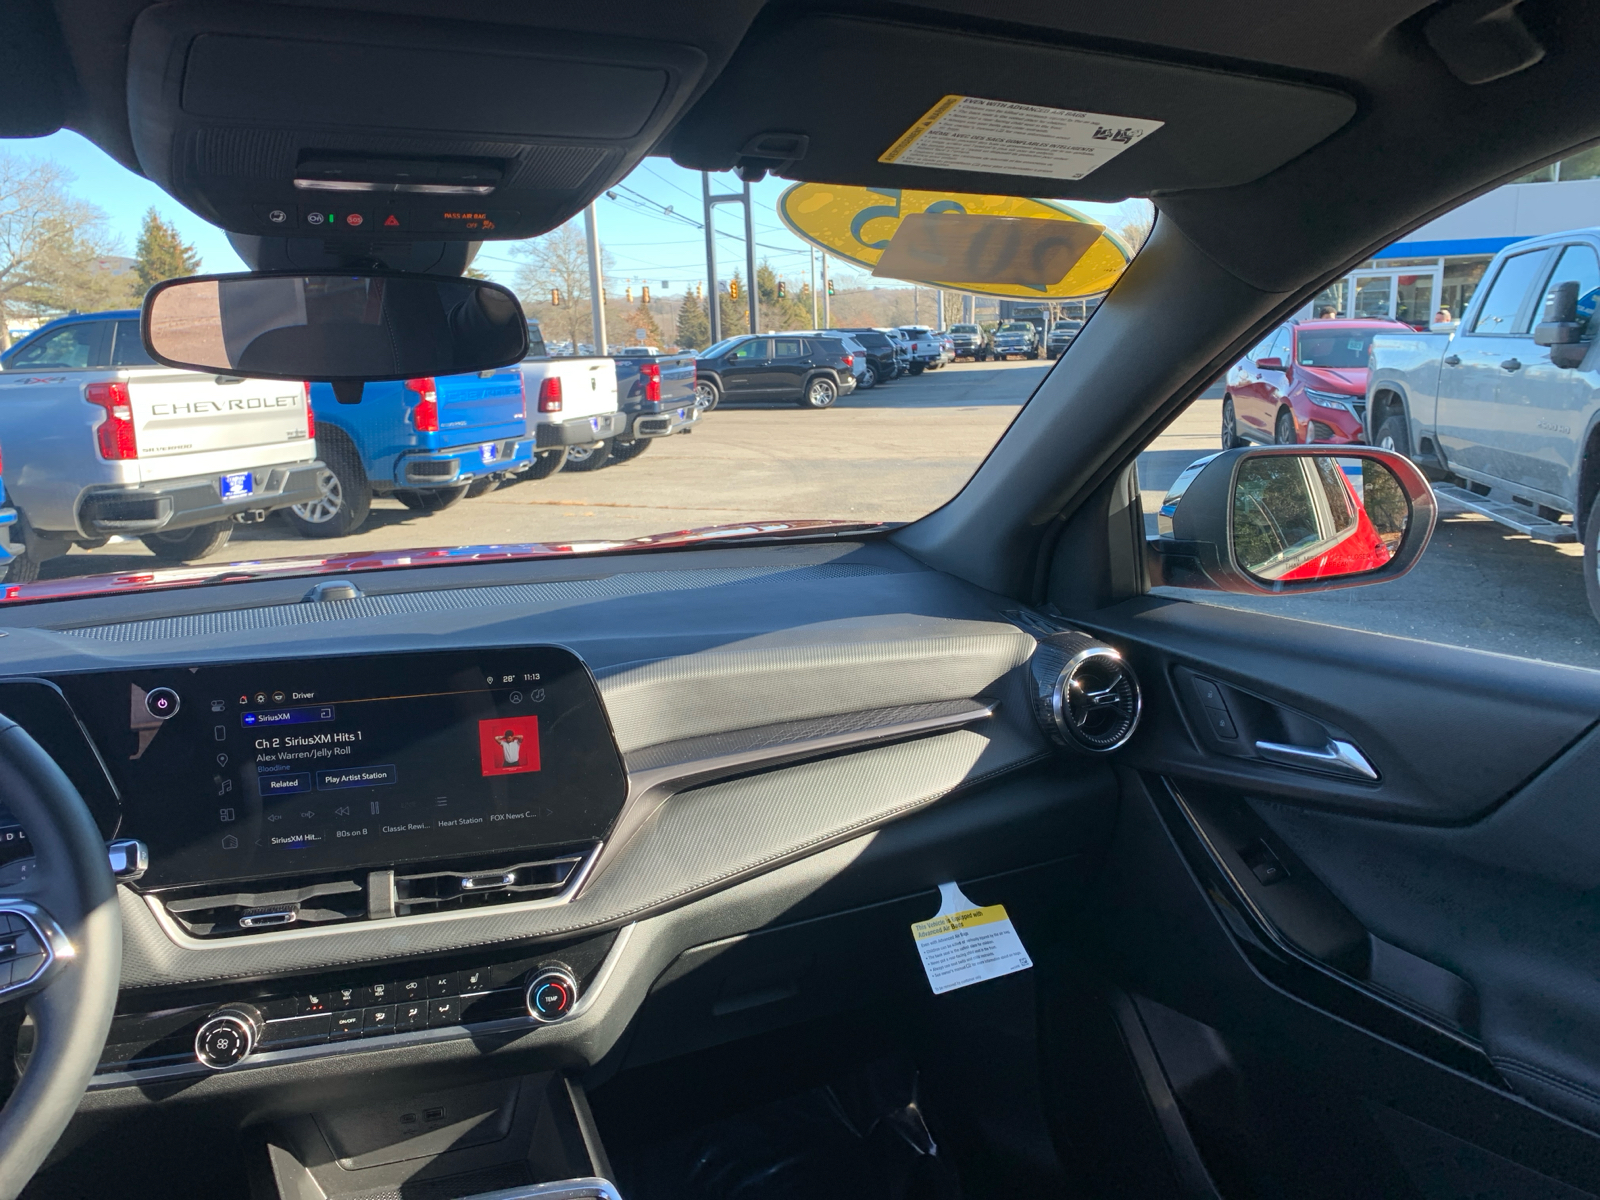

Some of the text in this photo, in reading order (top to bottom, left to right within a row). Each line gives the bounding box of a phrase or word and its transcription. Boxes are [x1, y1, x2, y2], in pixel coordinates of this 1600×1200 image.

[1007, 104, 1050, 112] ADVANCED
[151, 395, 299, 416] CHEVROLET
[258, 713, 290, 722] SiriusXM
[255, 738, 270, 749] Ch
[272, 738, 280, 747] 2
[285, 734, 332, 746] SiriusXM
[334, 732, 355, 742] Hits
[256, 746, 351, 762] Alex Warren/Jelly Roll
[258, 764, 290, 772] Bloodline
[325, 772, 388, 784] Play Artist Station
[270, 779, 298, 788] Related
[438, 817, 483, 827] Heart Station
[382, 825, 406, 833] Classic
[19, 831, 25, 839] L
[337, 830, 350, 838] 80s
[271, 835, 303, 844] SiriusXM
[926, 919, 945, 927] Vehicle
[951, 912, 973, 922] Equipped
[917, 927, 942, 937] Advanced
